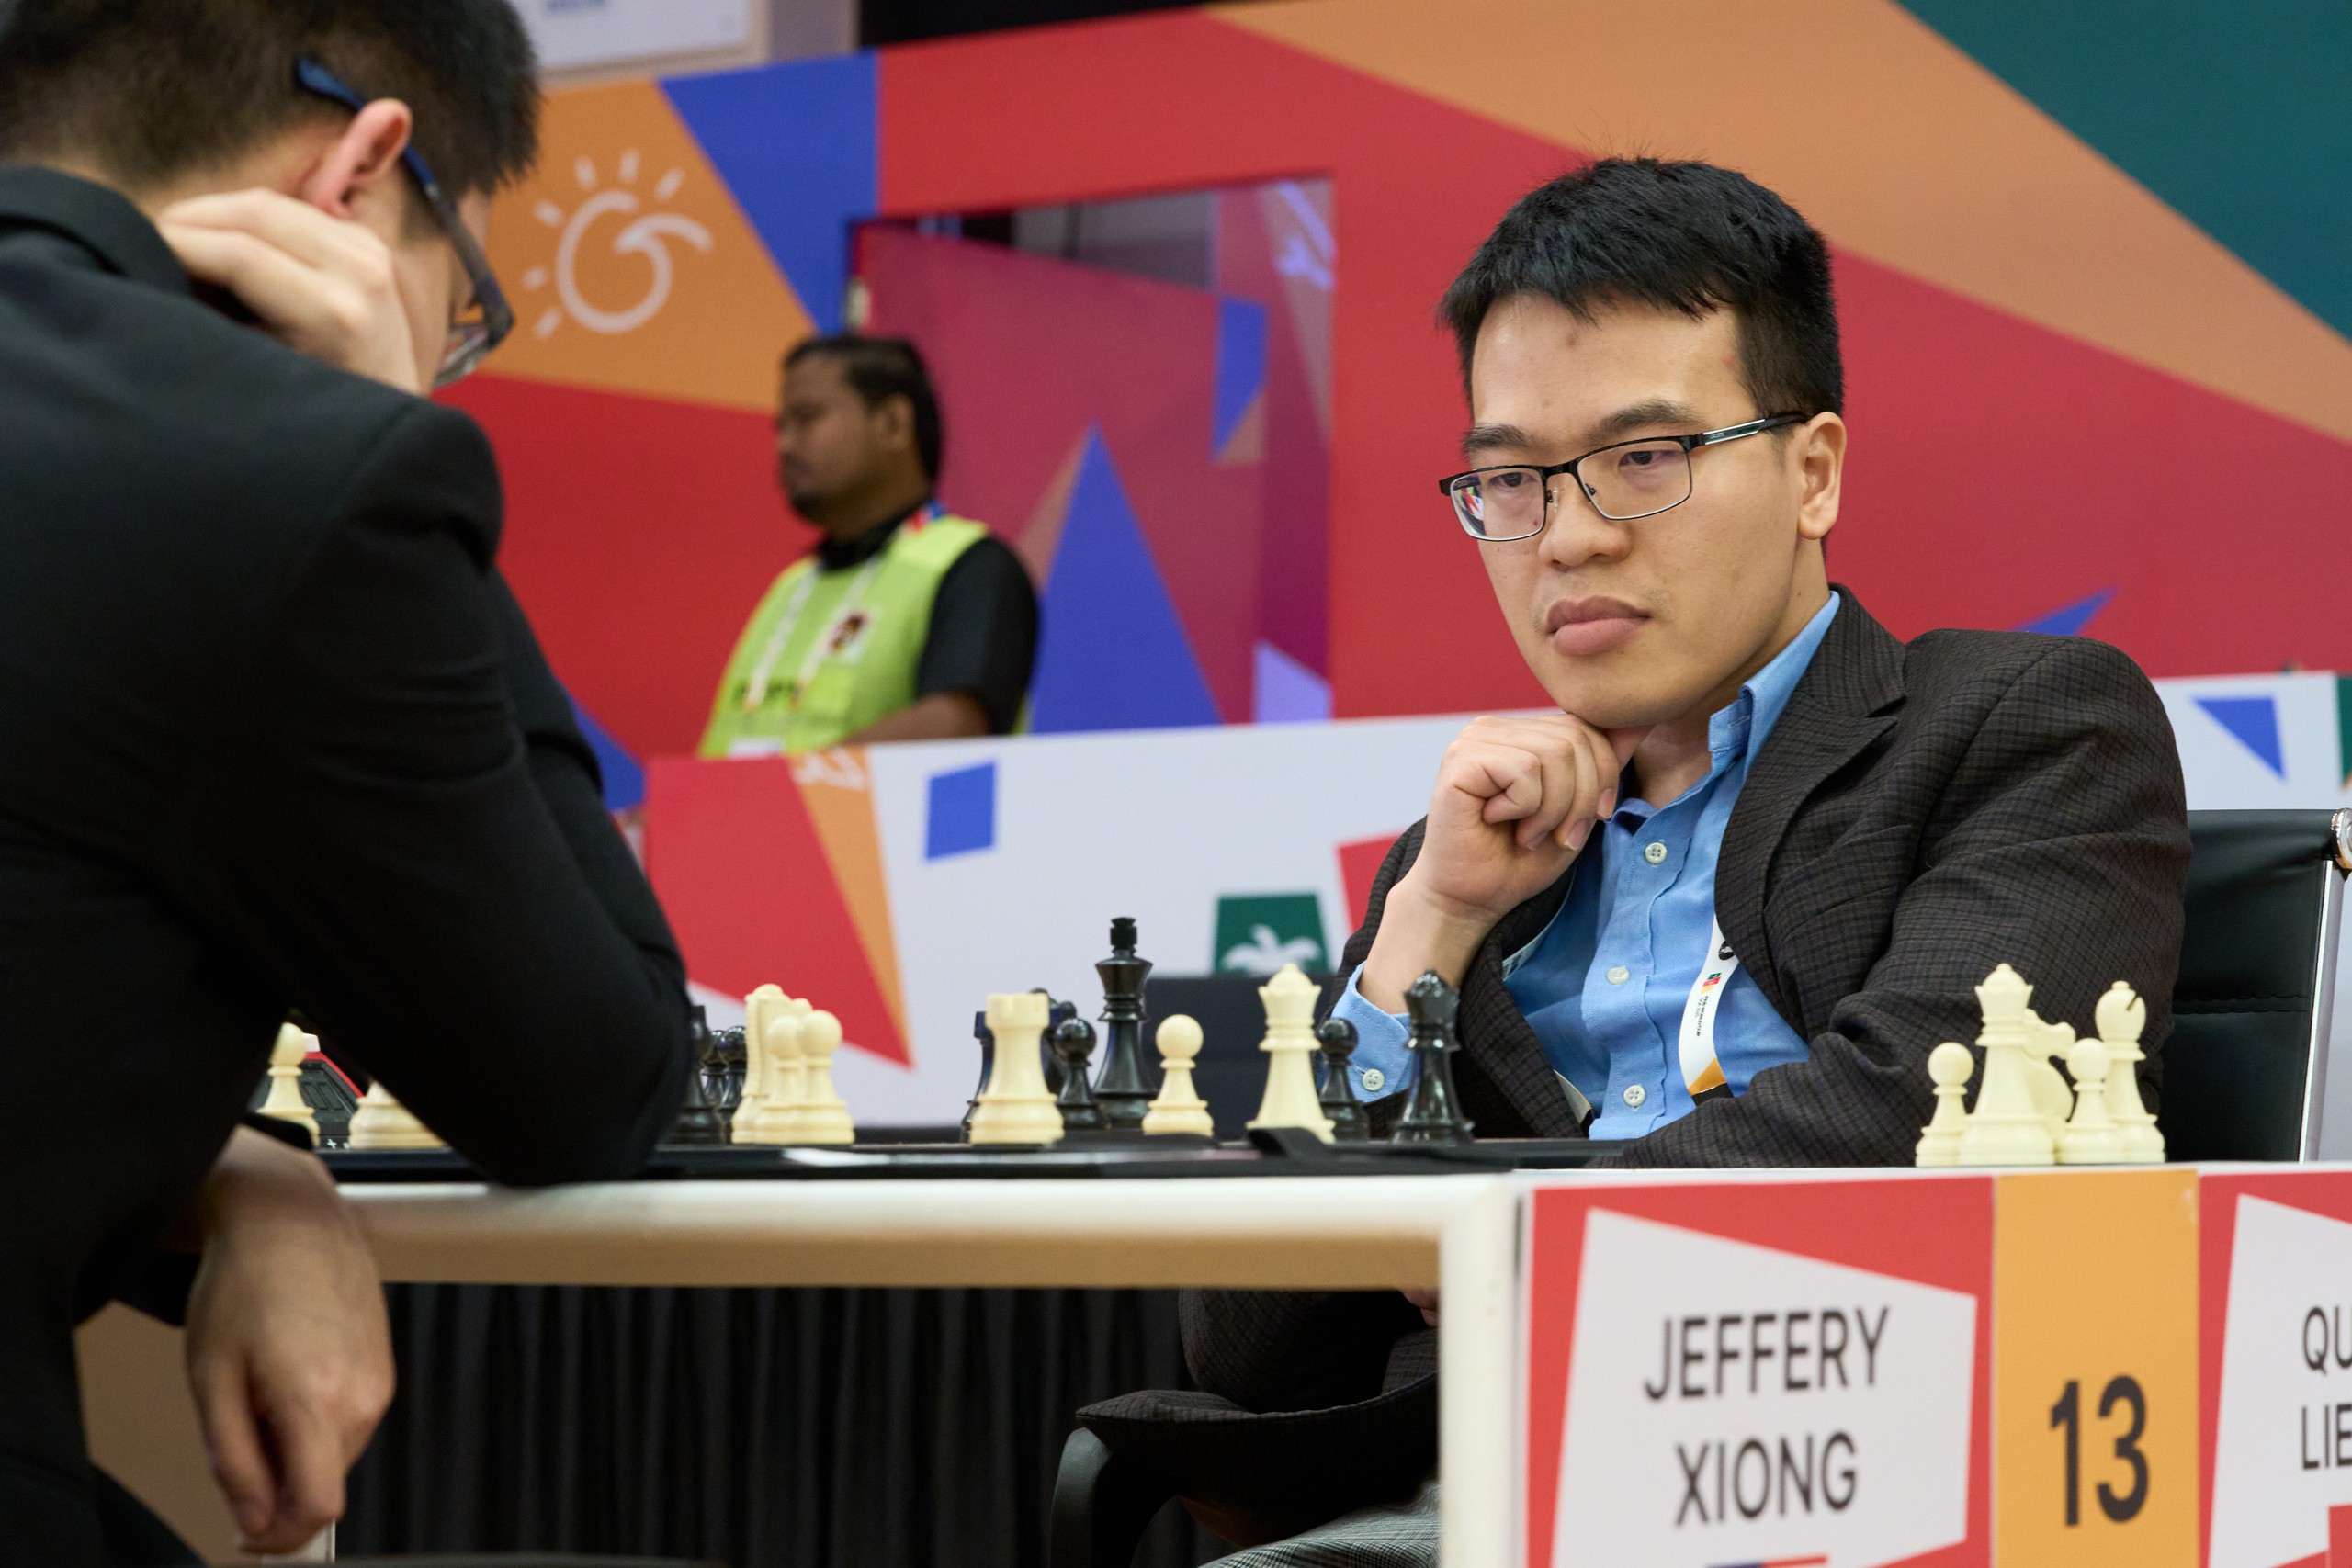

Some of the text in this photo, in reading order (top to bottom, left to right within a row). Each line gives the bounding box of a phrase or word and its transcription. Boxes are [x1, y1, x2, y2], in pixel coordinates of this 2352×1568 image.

[1645, 1305, 1890, 1402] JEFFERY
[1676, 1430, 1858, 1527] XIONG
[2050, 1374, 2150, 1528] 13
